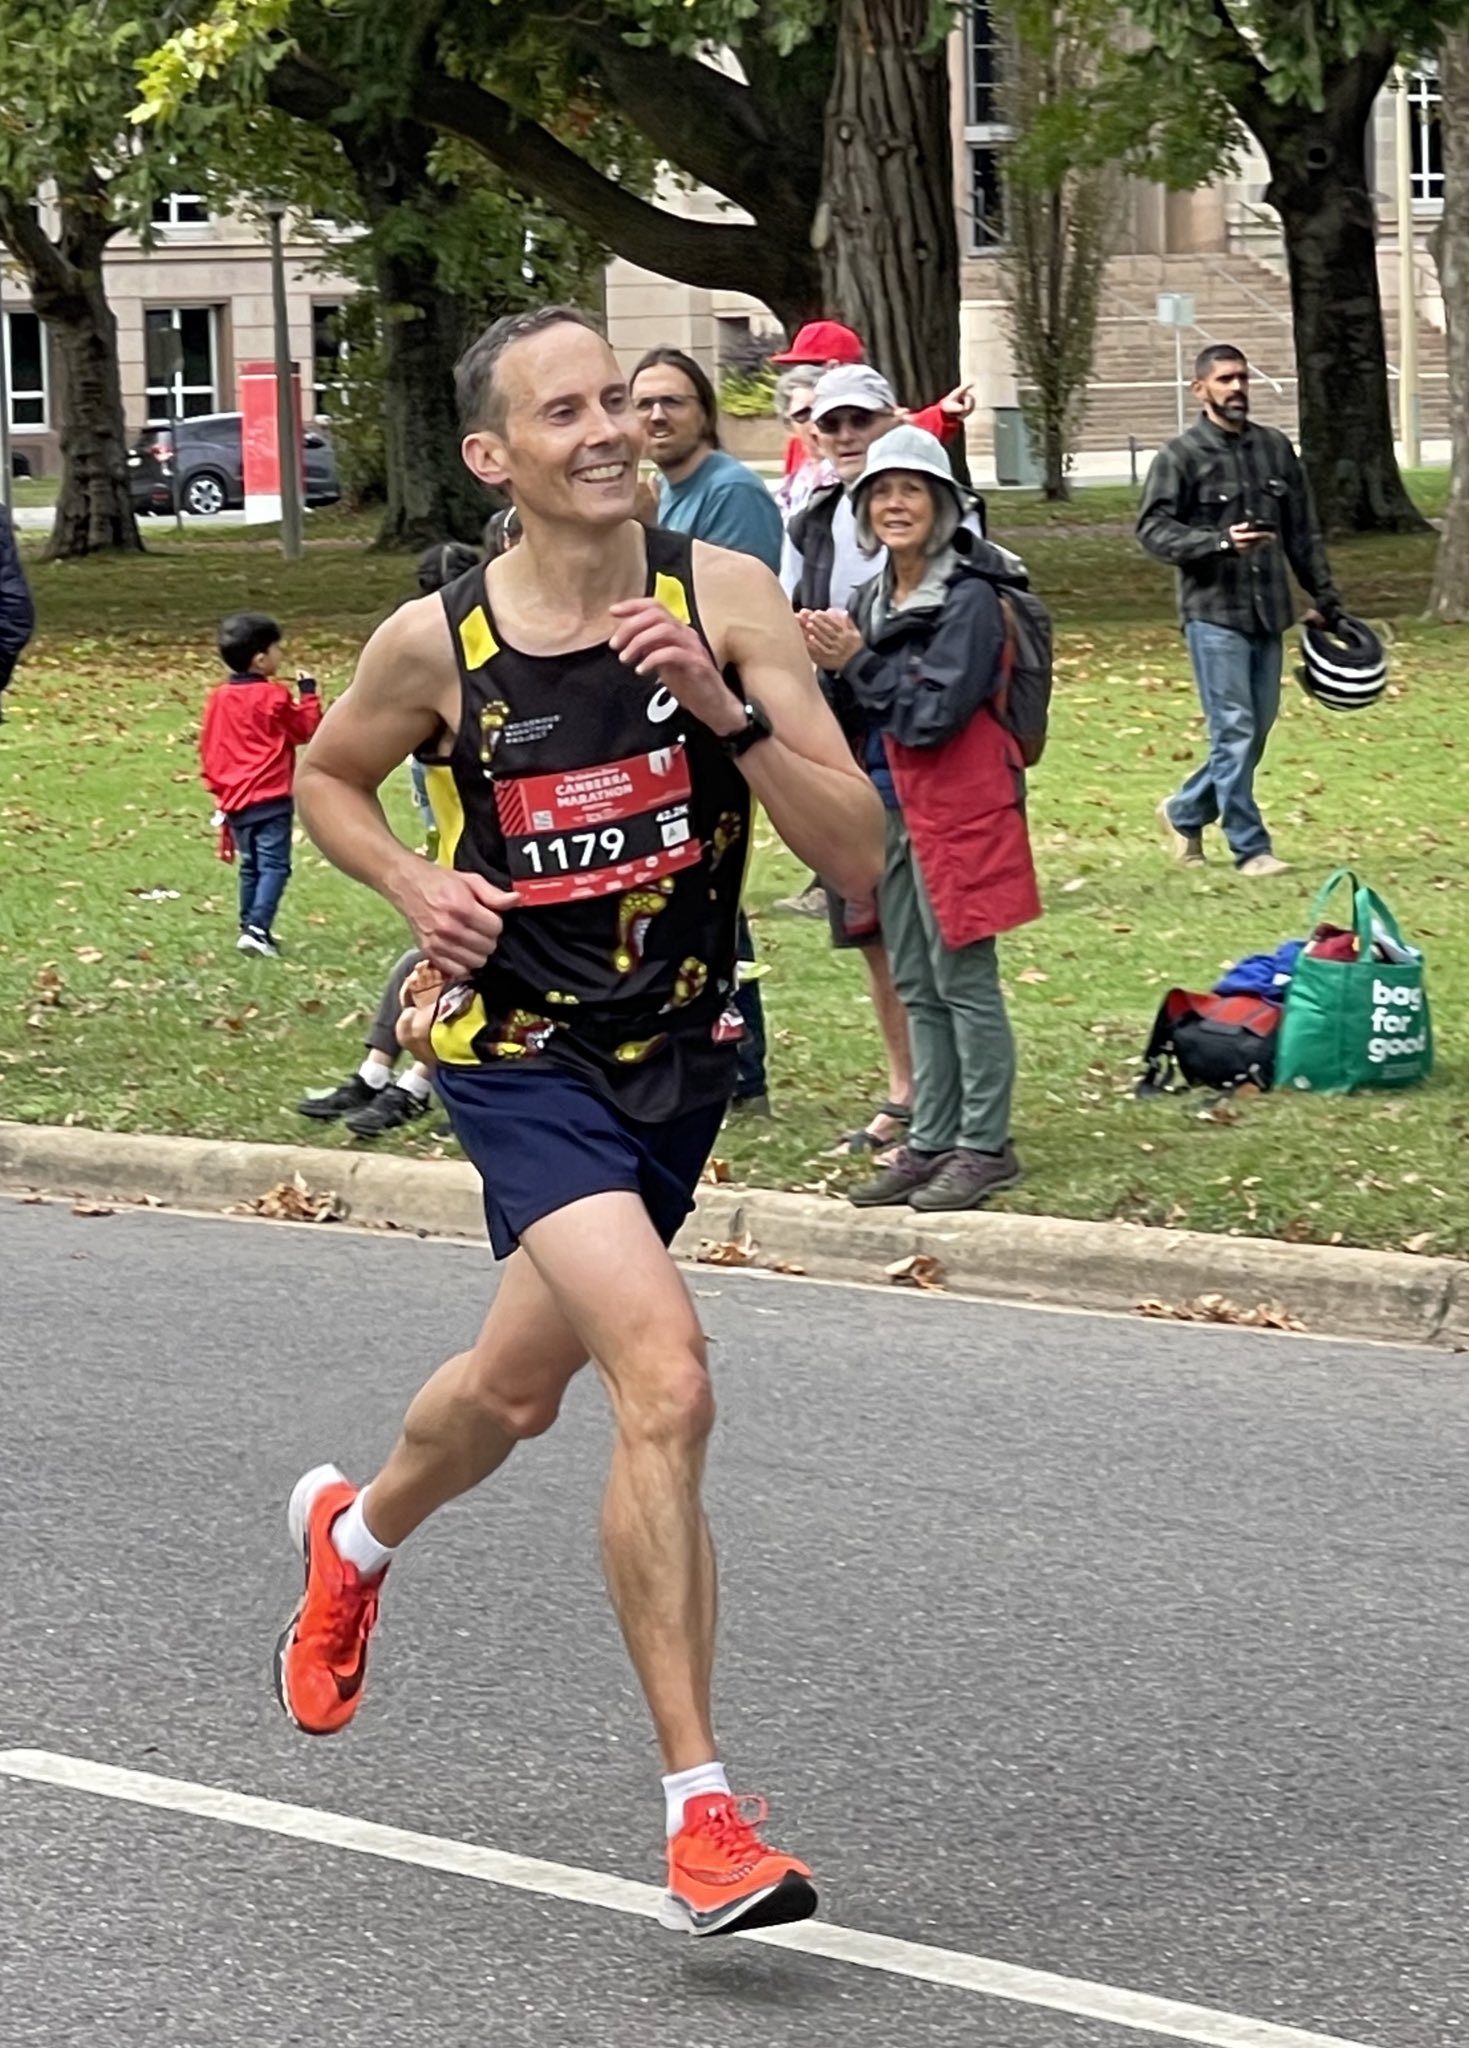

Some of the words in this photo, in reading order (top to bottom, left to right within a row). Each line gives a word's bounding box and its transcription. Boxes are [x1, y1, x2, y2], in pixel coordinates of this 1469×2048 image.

[555, 772, 631, 796] CANBERRA
[557, 783, 633, 808] MARATHON
[521, 827, 625, 873] 1179
[1372, 978, 1422, 1012] bag
[1370, 1006, 1412, 1034] for
